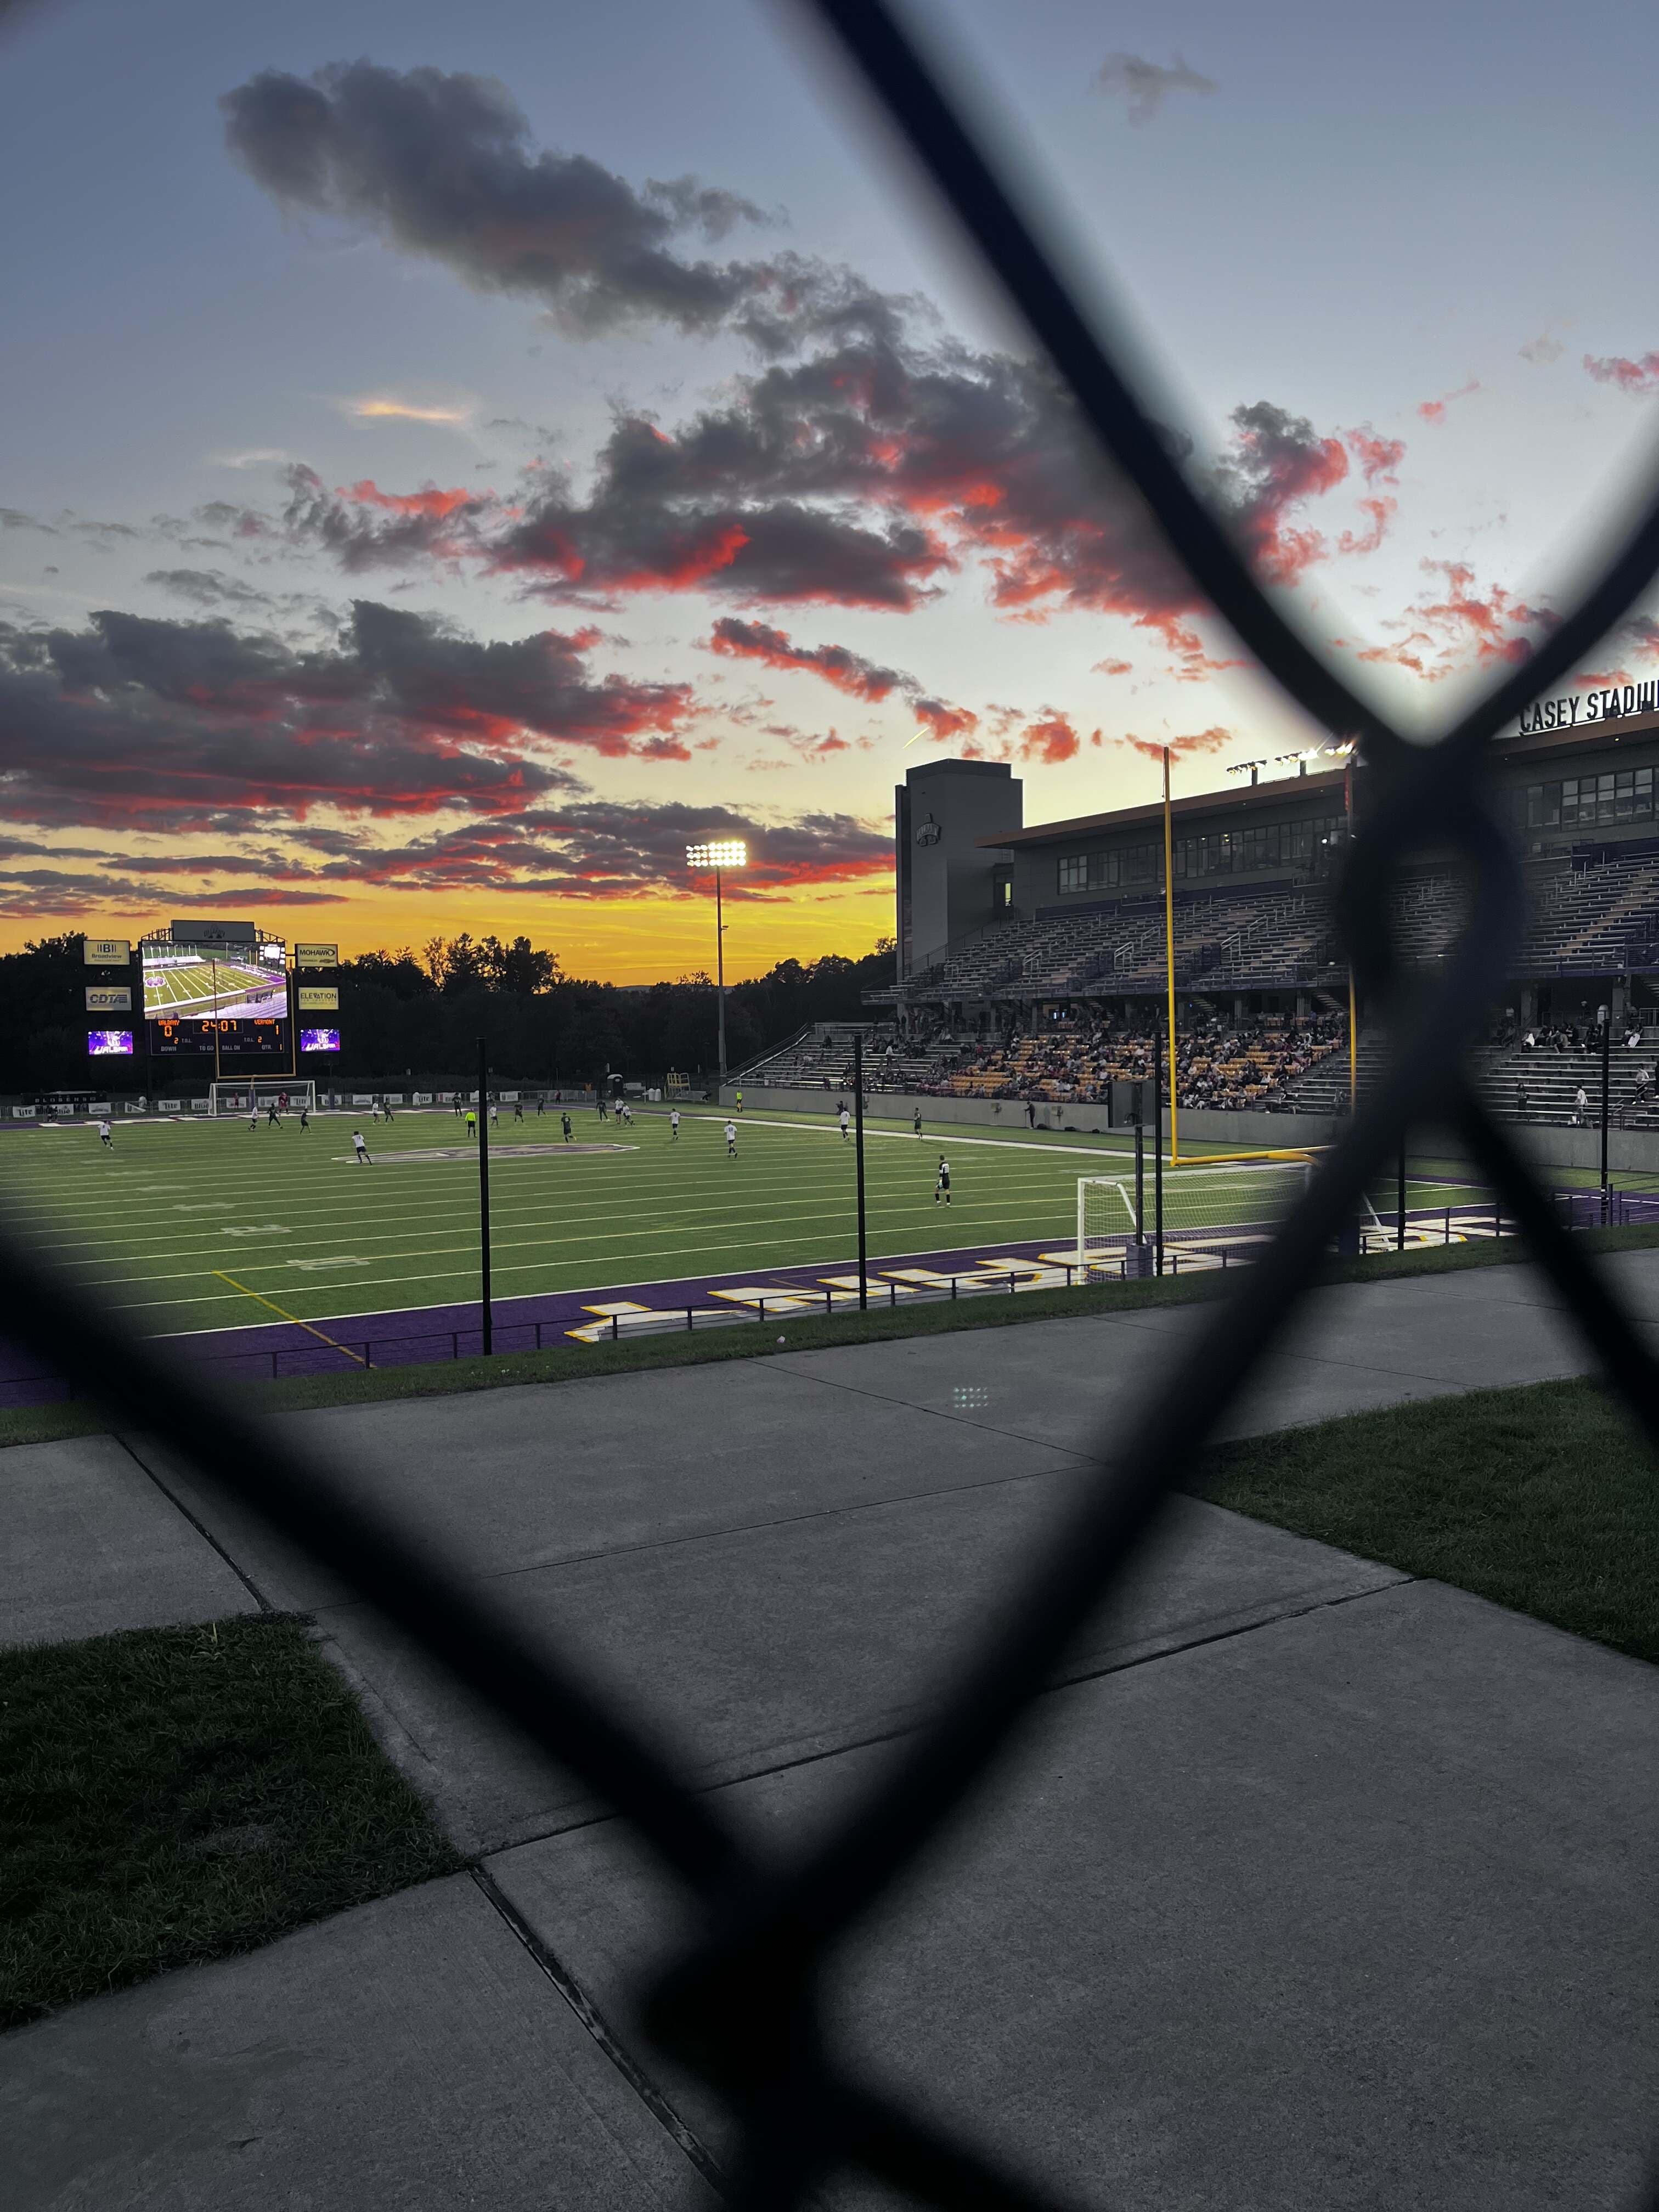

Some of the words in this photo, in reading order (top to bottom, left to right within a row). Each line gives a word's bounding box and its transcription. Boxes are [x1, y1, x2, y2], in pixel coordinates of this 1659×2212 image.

[1520, 696, 1579, 732] CASEY
[1587, 680, 1659, 719] STADIU
[164, 1025, 172, 1037] 0
[201, 1020, 237, 1032] 24:07
[275, 1025, 279, 1035] 1
